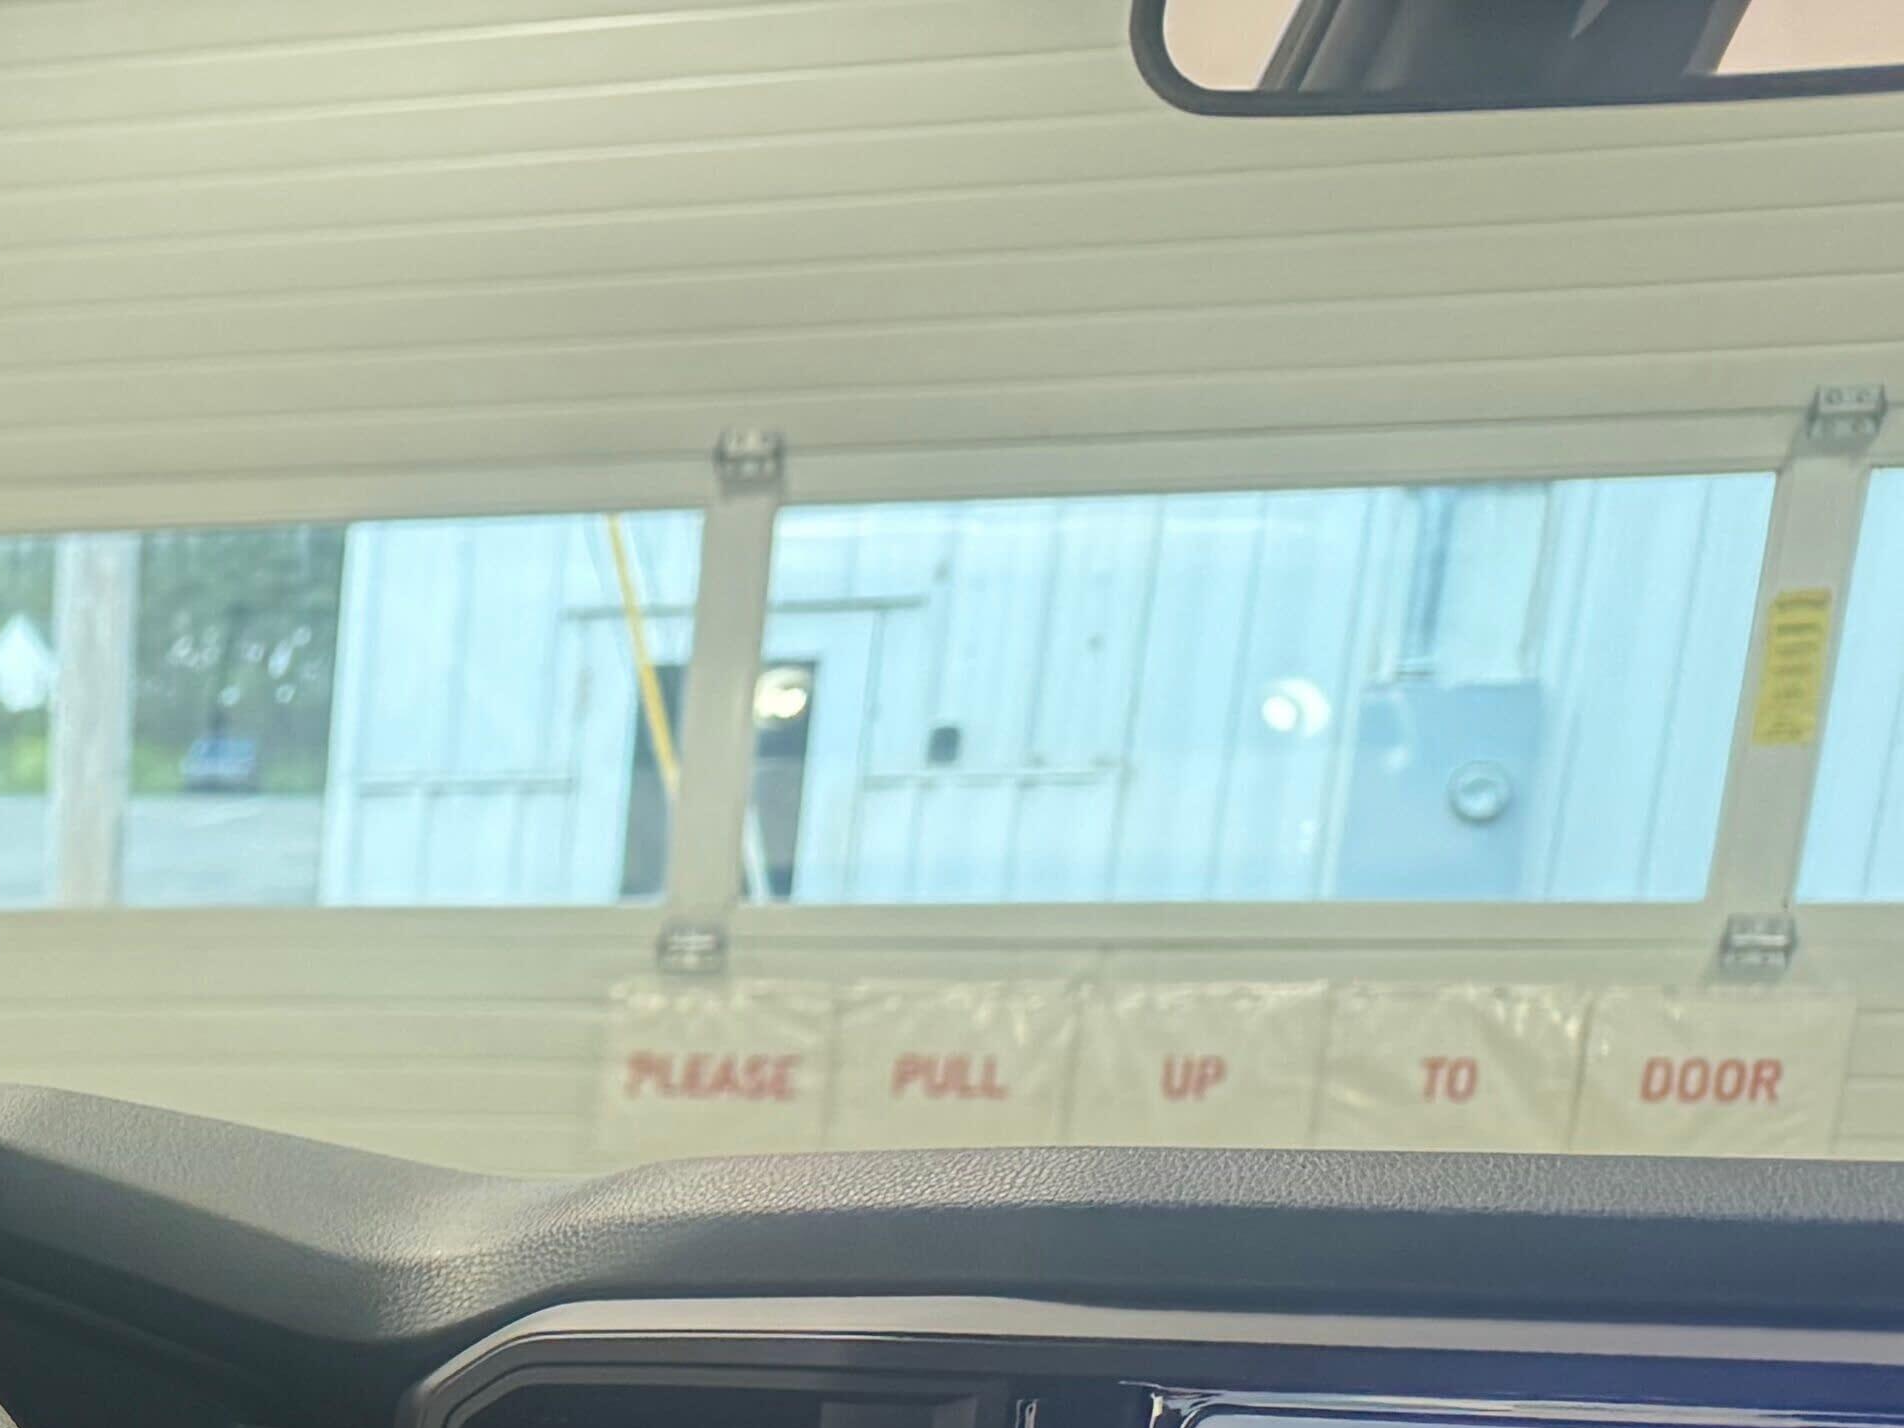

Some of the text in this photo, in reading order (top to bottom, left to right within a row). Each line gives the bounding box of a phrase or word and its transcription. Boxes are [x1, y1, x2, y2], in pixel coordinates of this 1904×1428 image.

[625, 1051, 1783, 1106] PLEASE PULL UP TO DOOR
